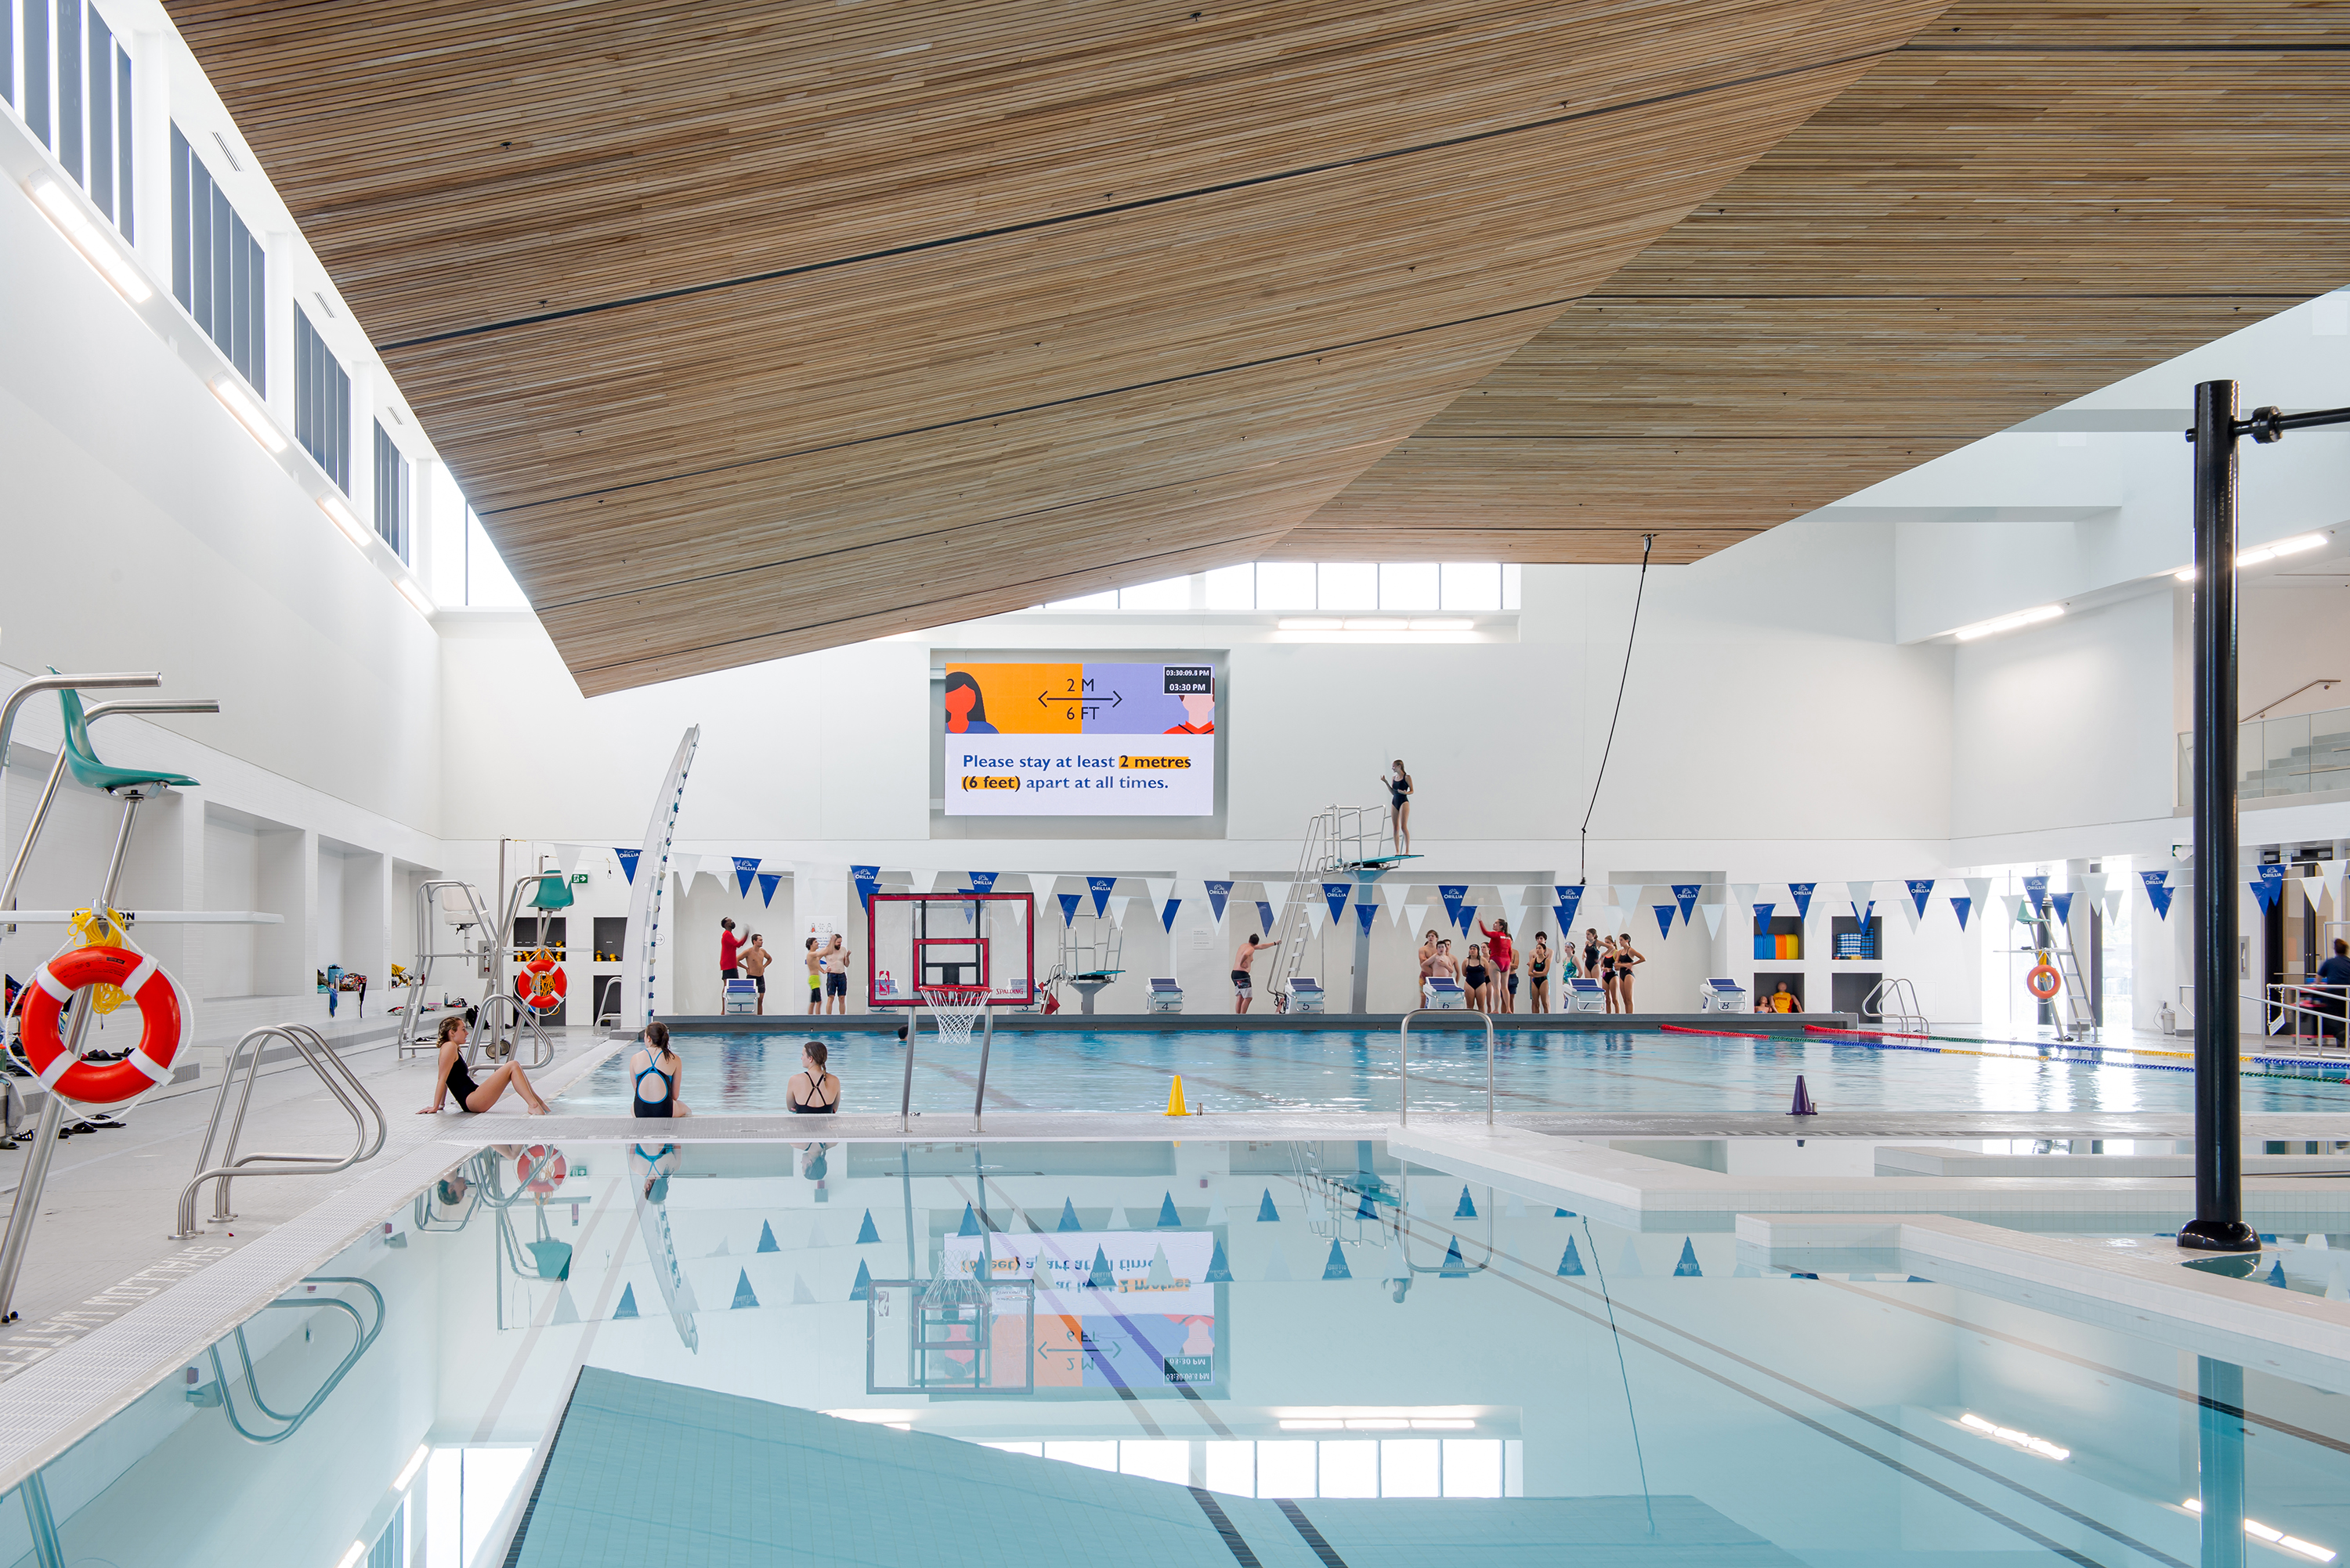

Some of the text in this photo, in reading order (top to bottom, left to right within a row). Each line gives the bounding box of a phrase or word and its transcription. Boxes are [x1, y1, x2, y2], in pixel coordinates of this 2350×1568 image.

[1067, 678, 1094, 692] 2 M
[1067, 706, 1100, 720] 6 FT
[964, 754, 1191, 771] Please stay at least 2 metres
[963, 775, 1169, 792] (6 feet) apart at all times.
[737, 1003, 743, 1012] 1
[0, 1246, 233, 1376] SHALLOW WATE
